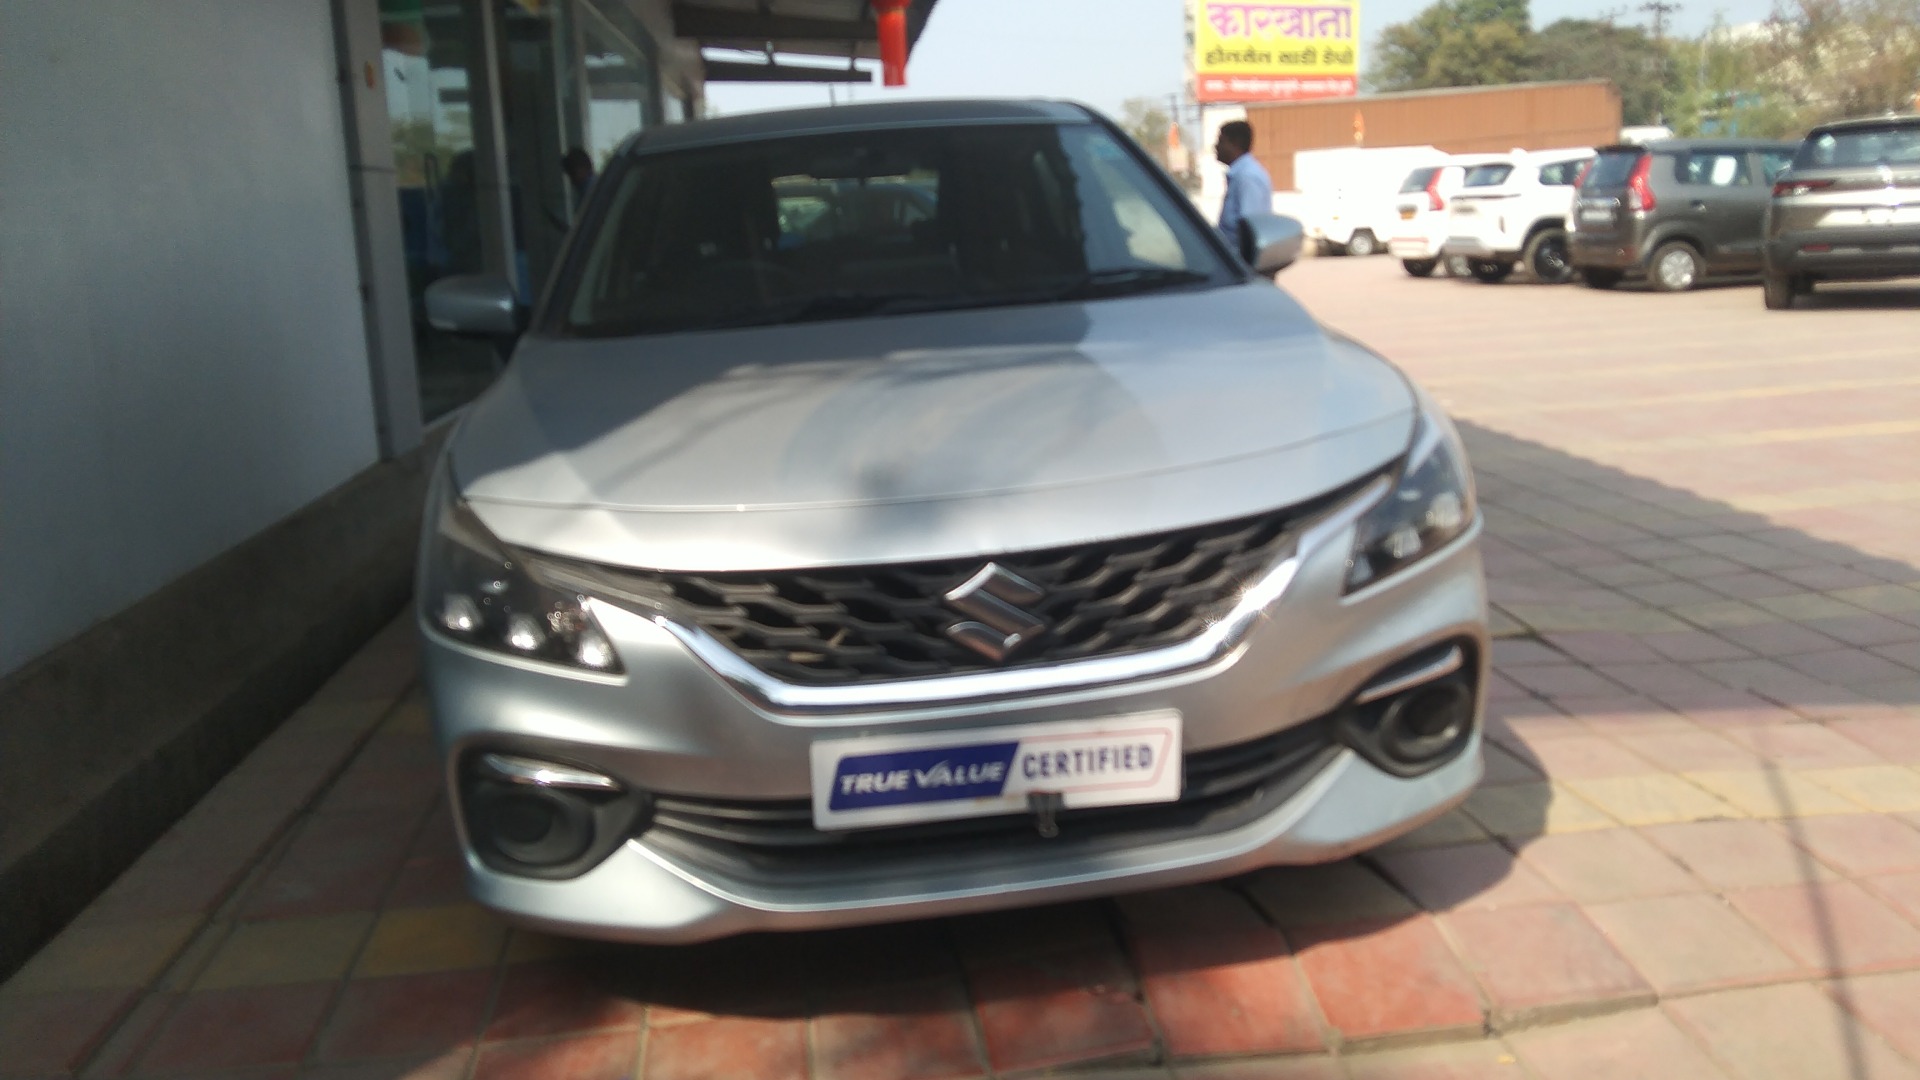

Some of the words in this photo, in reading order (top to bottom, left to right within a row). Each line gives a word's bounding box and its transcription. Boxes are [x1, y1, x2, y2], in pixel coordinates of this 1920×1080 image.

[840, 770, 910, 795] TRUE
[914, 760, 1004, 788] VALUE
[1022, 744, 1153, 779] CERTIFIED
